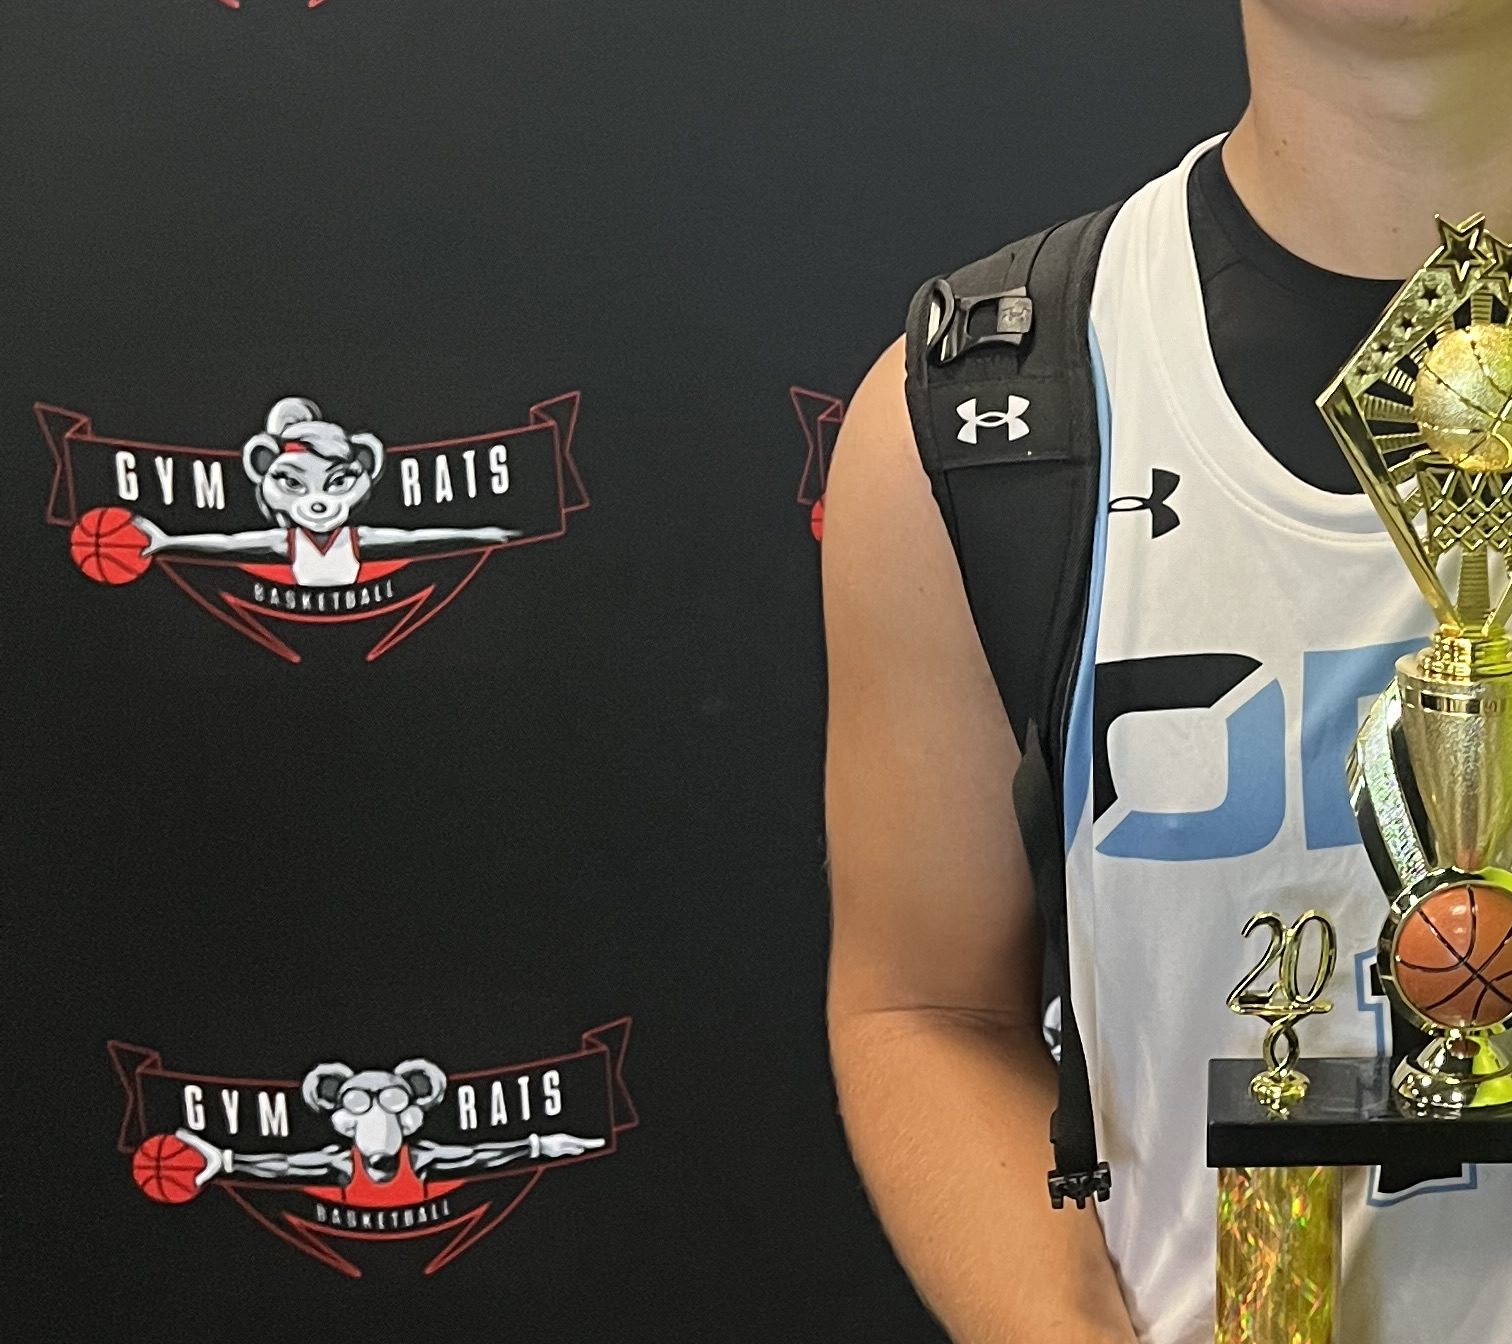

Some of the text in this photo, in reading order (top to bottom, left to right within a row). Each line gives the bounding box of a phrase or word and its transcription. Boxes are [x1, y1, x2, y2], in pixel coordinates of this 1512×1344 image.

[116, 445, 508, 509] GYM RATS
[255, 580, 392, 611] BASKETBALL
[1226, 910, 1337, 1009] 20
[184, 1070, 561, 1136] GYM RATS
[316, 1200, 449, 1232] BASKETBALL
